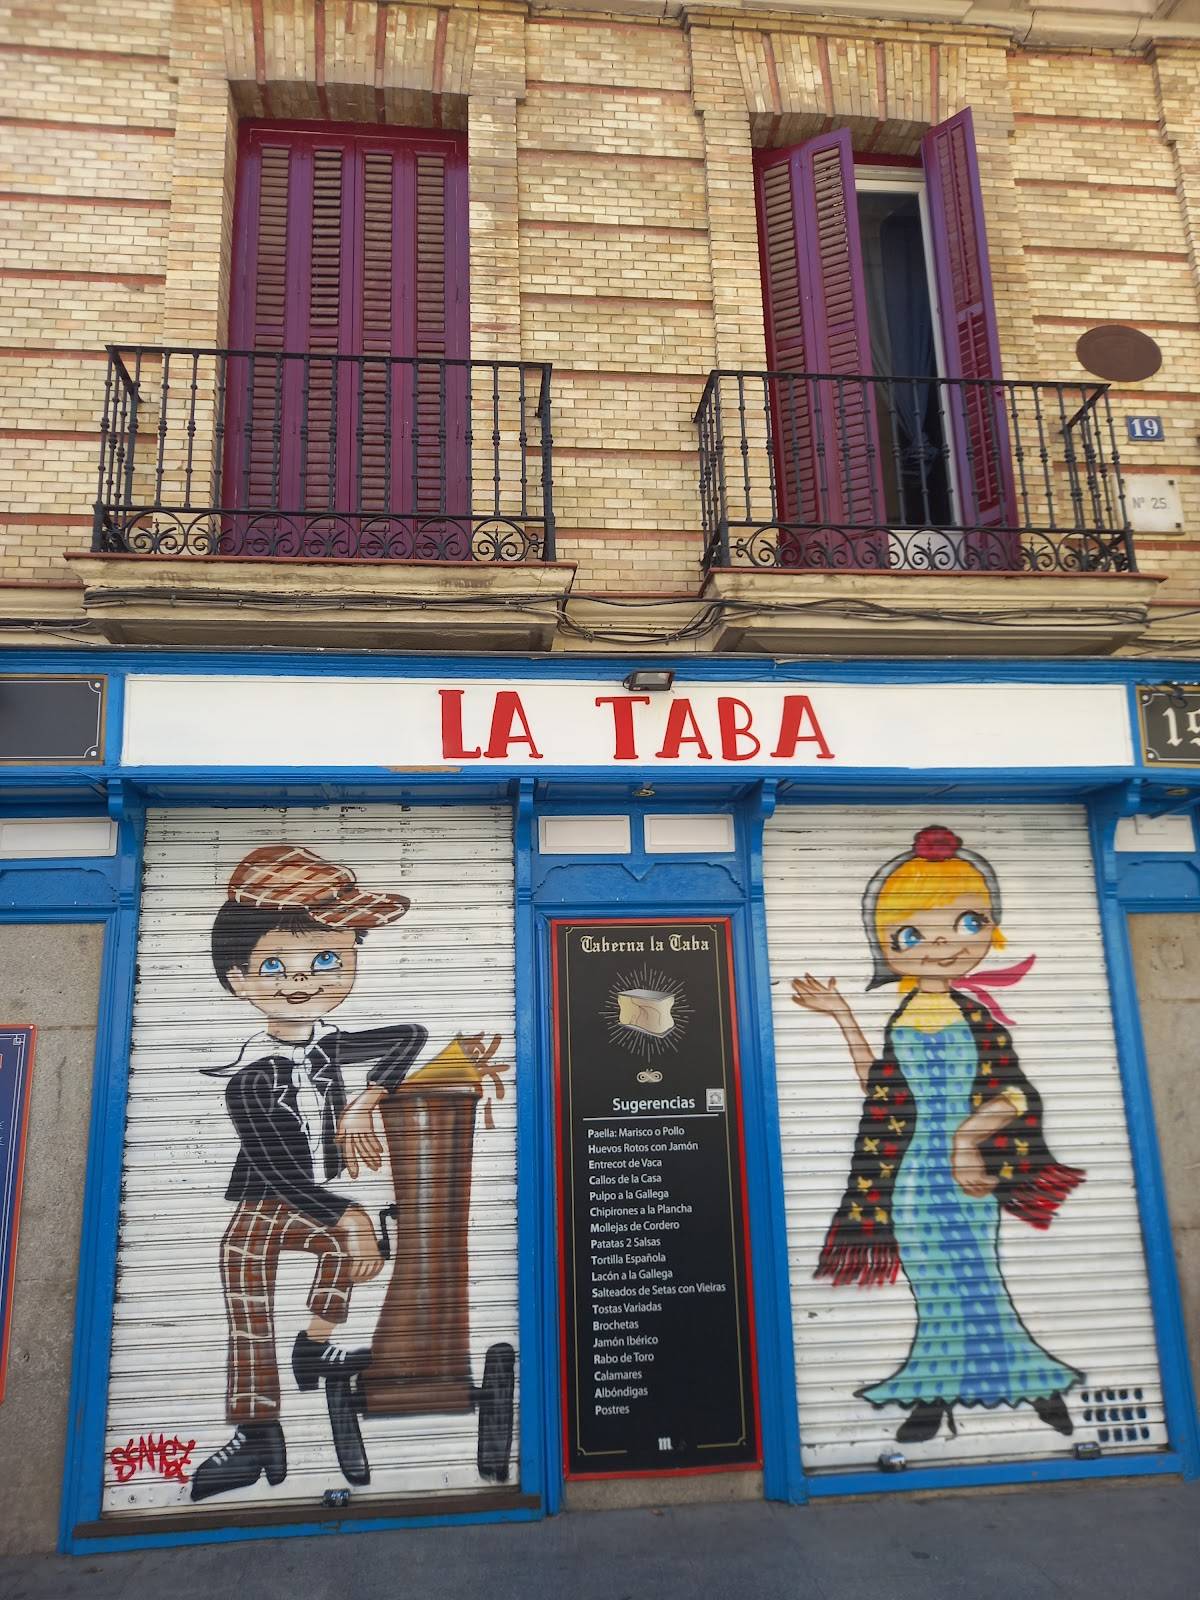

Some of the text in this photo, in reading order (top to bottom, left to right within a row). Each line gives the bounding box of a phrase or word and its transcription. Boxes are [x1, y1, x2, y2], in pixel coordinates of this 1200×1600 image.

[1131, 418, 1159, 438] 19
[1151, 497, 1167, 509] 25
[438, 689, 836, 761] LA TABA
[580, 933, 710, 953] Taberna la Taba
[612, 1096, 696, 1114] Sugerencias
[588, 1128, 617, 1139] Paella:
[619, 1127, 653, 1137] Marisco
[662, 1126, 685, 1136] Pollo
[588, 1141, 699, 1154] Huevos Rotos con Jamón
[588, 1158, 662, 1169] Entrecot de Vaca
[589, 1174, 662, 1185] Callos de la Casa
[589, 1189, 669, 1202] Pulpo a la Gallega
[590, 1204, 693, 1218] Chipirones a la Plancha
[590, 1220, 680, 1234] Mollejas de Cordero
[590, 1237, 661, 1249] Patatas 2 Salsas
[591, 1252, 666, 1265] Tortilla Española
[591, 1269, 673, 1282] Lacón a la Gallega
[592, 1282, 726, 1298] Salteados de Setas con Vieiras
[592, 1302, 662, 1314] Tostas Variadas
[592, 1320, 639, 1331] Brochetas
[593, 1335, 659, 1348] Jamón Ibérico
[593, 1352, 655, 1365] Rabo de Toro
[594, 1370, 643, 1381] Calamares
[594, 1386, 649, 1399] Albóndigas
[595, 1405, 630, 1416] Postres
